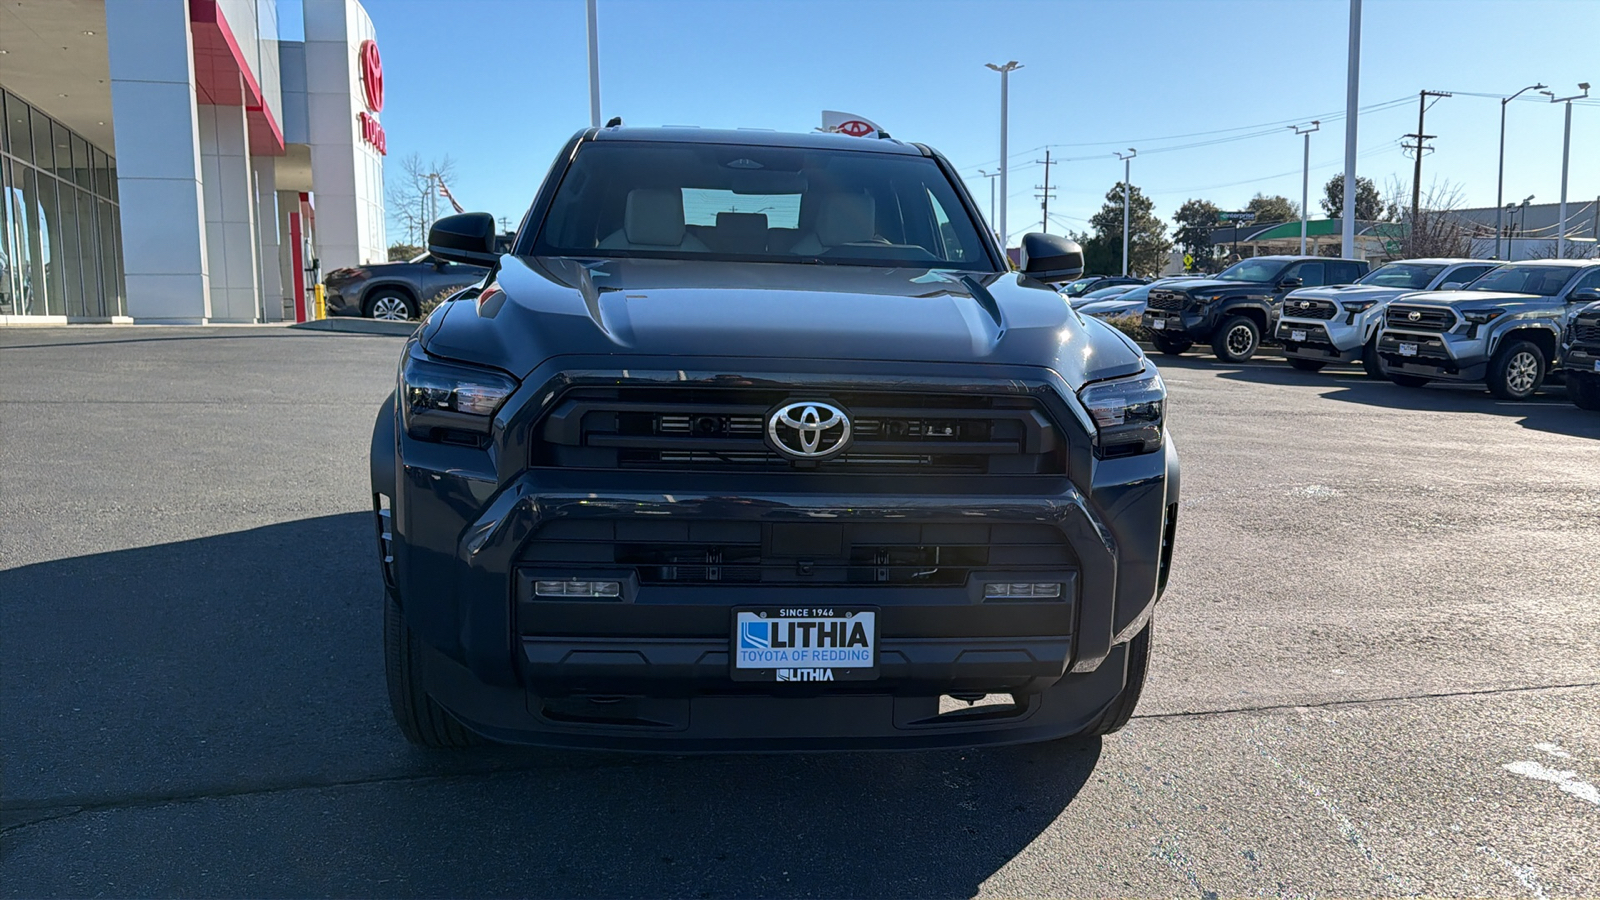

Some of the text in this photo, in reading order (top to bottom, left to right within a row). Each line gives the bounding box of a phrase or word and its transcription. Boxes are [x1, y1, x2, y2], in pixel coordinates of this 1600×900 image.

[779, 608, 834, 617] SINCE 1946
[771, 621, 869, 648] LITHIA
[741, 649, 869, 662] TOYOTA OF REDDING
[789, 668, 834, 681] LITHIA
